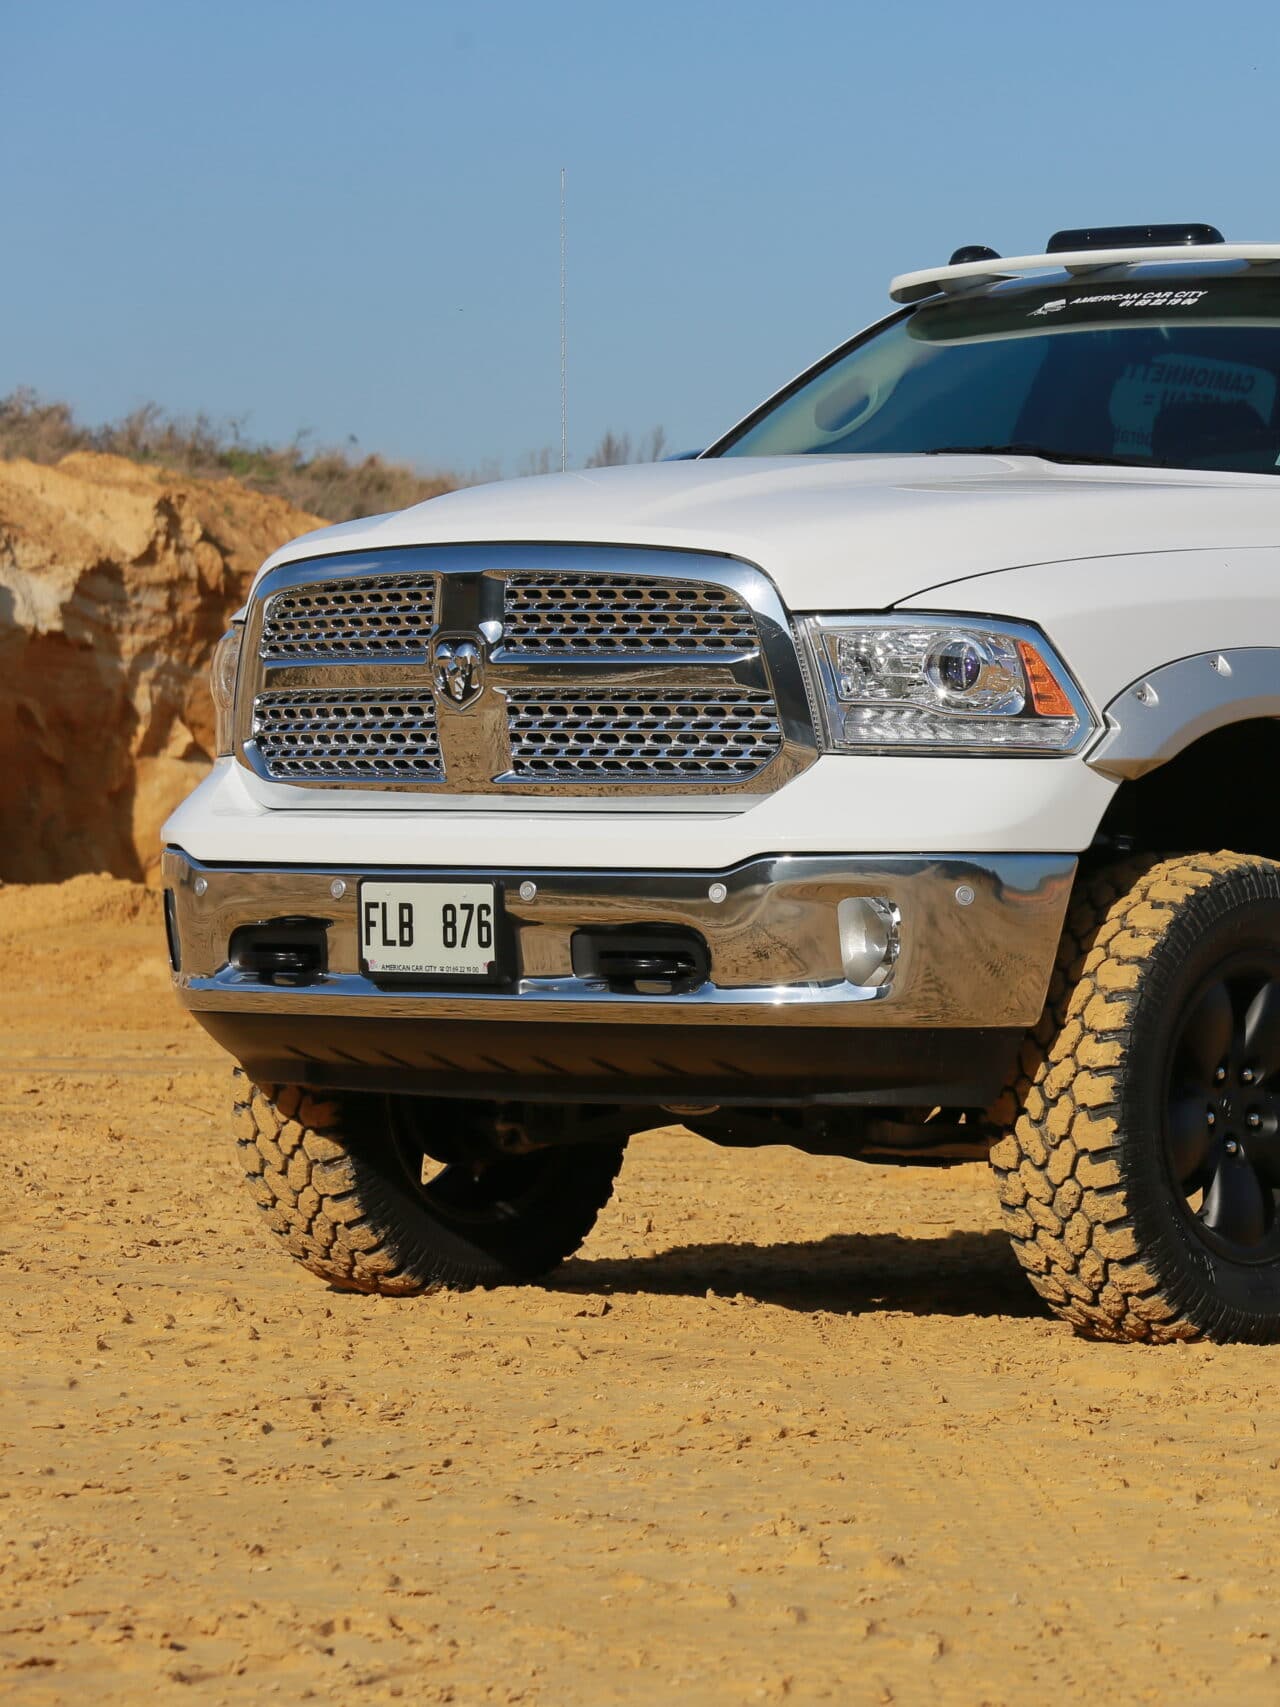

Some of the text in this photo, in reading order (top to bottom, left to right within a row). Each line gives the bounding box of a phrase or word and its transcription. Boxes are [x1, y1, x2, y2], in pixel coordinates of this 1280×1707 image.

[1069, 290, 1209, 305] AMERICAN CAR CITY
[364, 901, 492, 949] FLB 876
[411, 964, 423, 972] CAR
